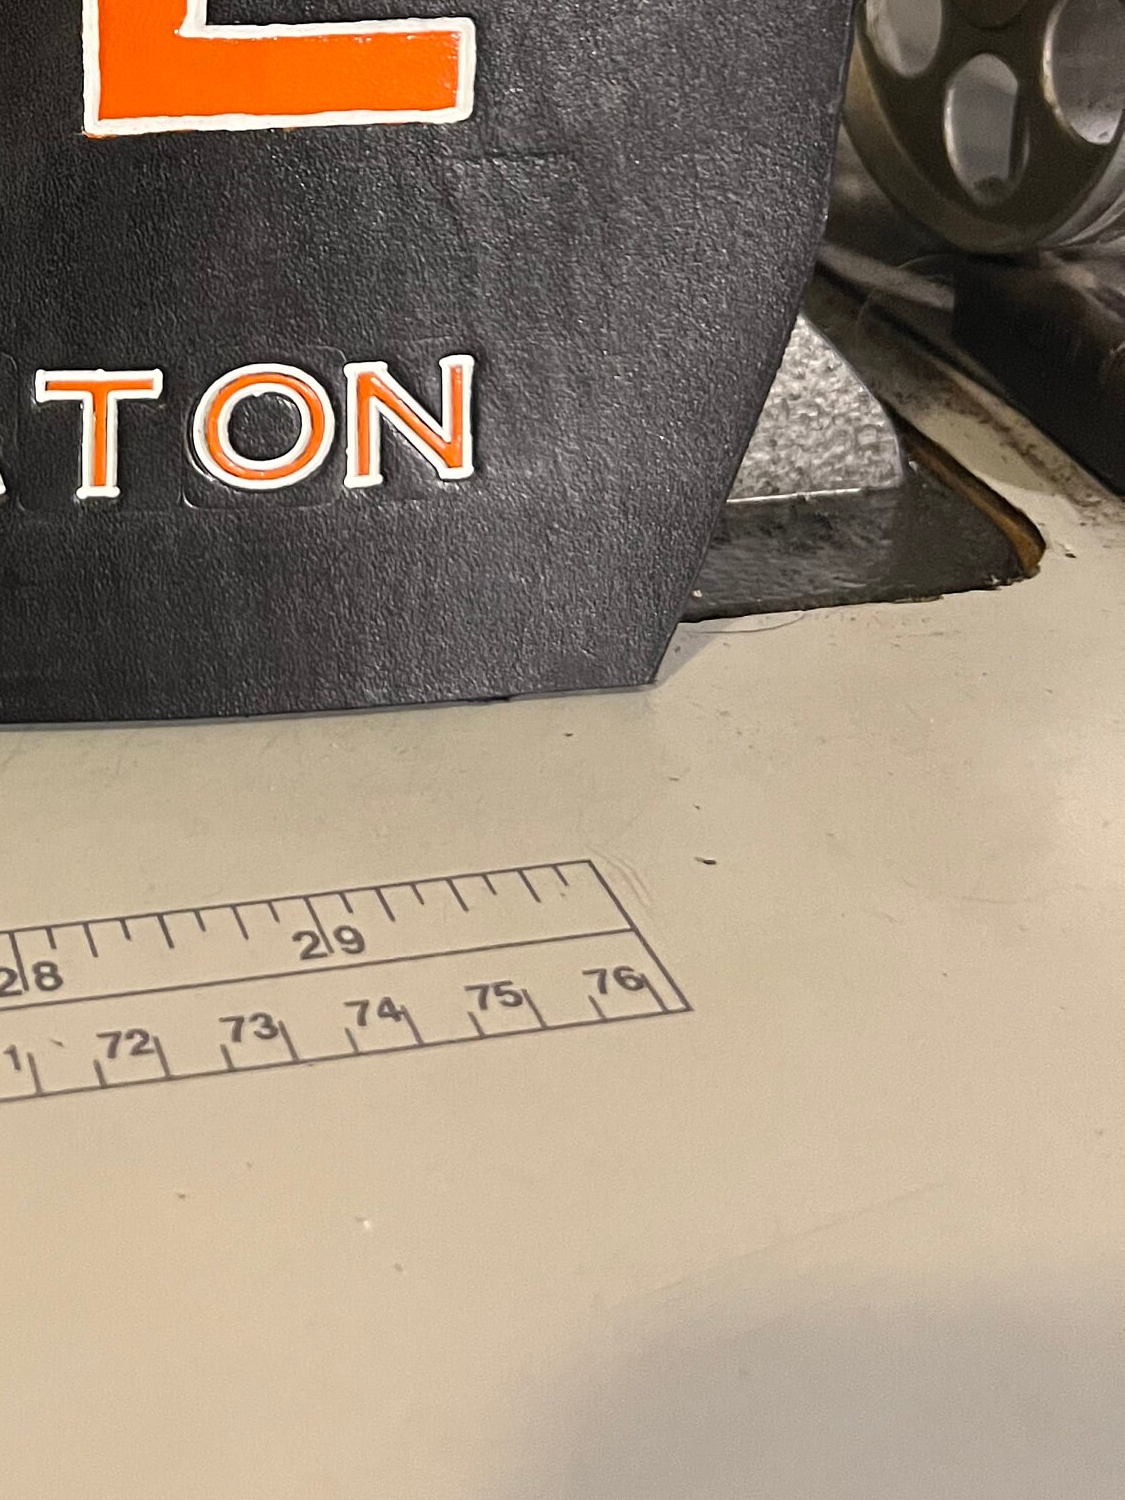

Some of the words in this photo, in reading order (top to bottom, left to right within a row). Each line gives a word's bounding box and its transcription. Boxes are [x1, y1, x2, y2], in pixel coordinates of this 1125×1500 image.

[292, 924, 365, 960] 29
[96, 1028, 155, 1059] 72
[220, 1012, 279, 1043] 73
[344, 996, 406, 1027] 74
[464, 980, 524, 1011] 75
[582, 965, 645, 996] 76
